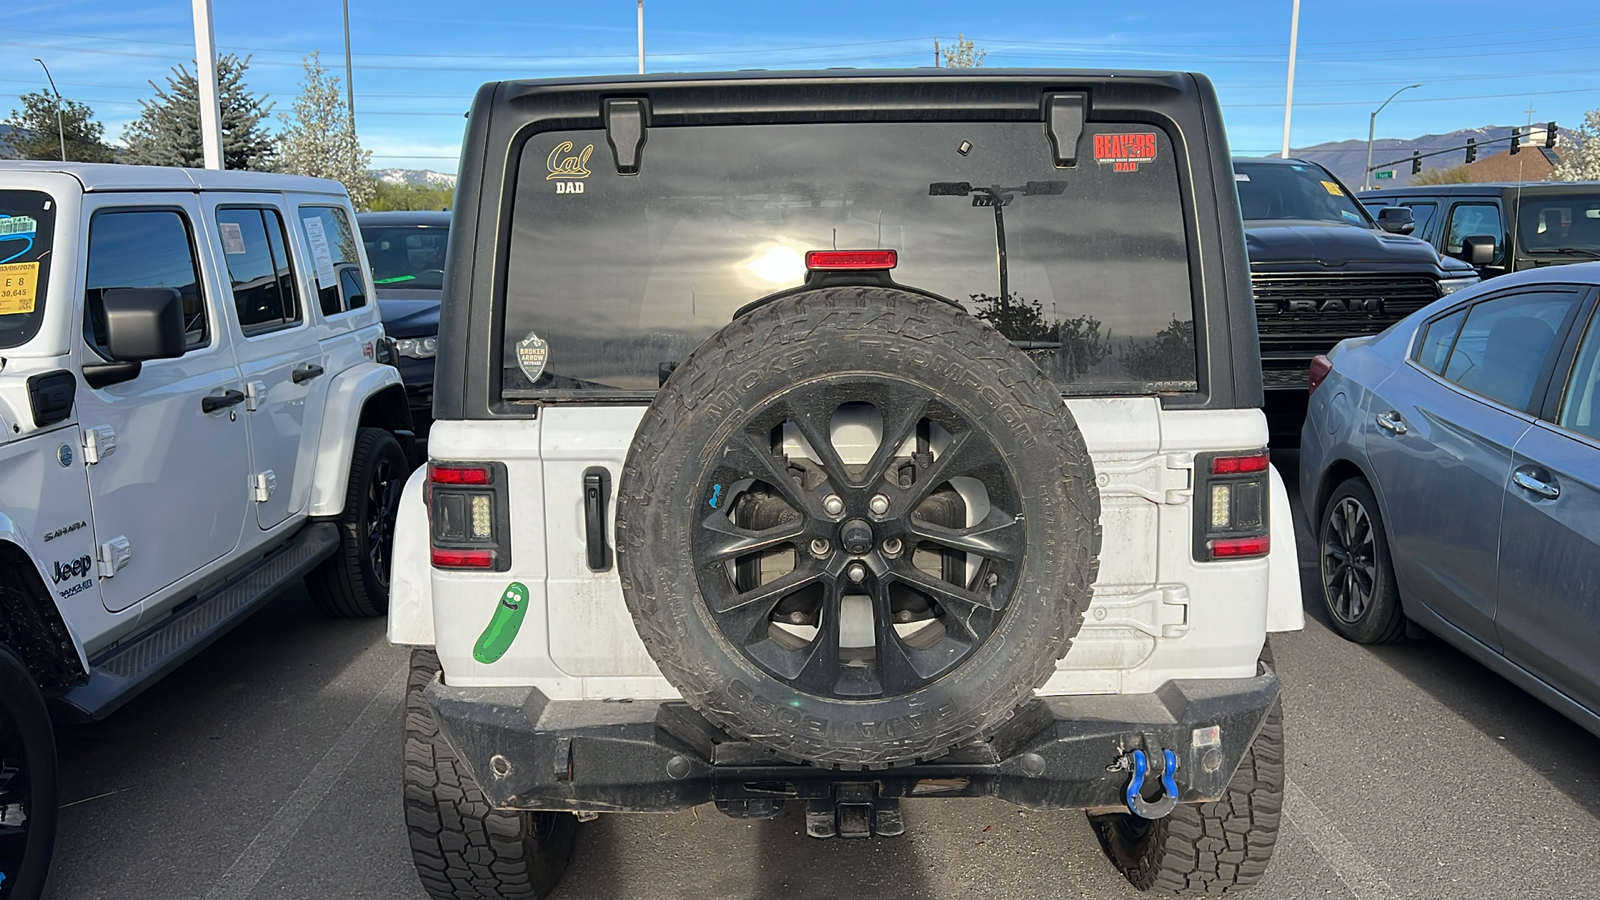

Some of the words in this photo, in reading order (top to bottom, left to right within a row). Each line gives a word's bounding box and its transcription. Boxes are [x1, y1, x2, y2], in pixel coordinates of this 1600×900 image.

[1094, 134, 1155, 158] BEAVERS
[546, 140, 594, 180] Cal
[1115, 162, 1137, 171] DAD
[556, 182, 584, 194] DAD
[5, 278, 12, 287] E
[18, 277, 24, 286] 8
[1288, 299, 1380, 312] RAM
[704, 342, 829, 422] MICKEY
[858, 340, 1038, 450] THOMPSON
[44, 520, 87, 542] SAHARA
[51, 553, 92, 585] Jeep
[726, 677, 829, 738] BOSS
[855, 697, 959, 739] BAJA
